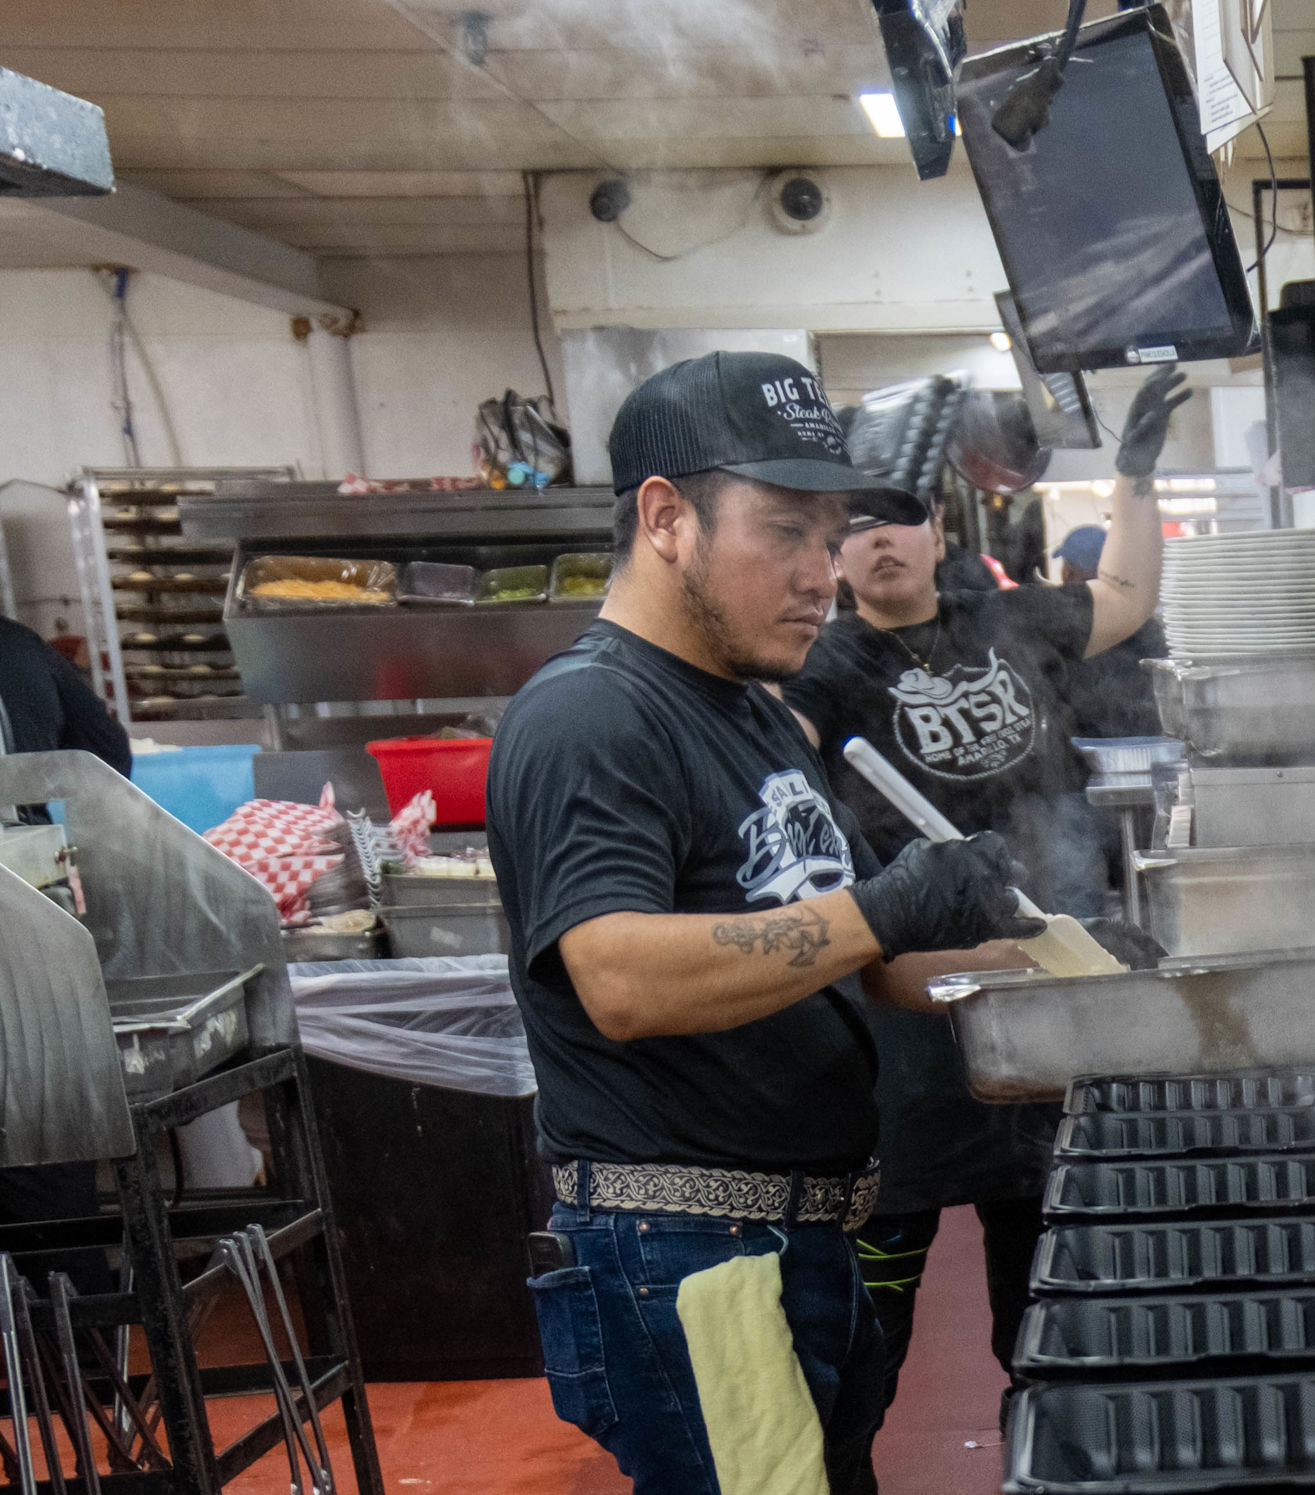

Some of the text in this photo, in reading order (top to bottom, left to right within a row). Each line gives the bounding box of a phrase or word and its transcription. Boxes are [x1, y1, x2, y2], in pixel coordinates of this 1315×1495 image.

[761, 376, 829, 407] BIG TE
[783, 402, 823, 420] Steak
[904, 670, 1031, 754] BTSR
[1008, 732, 1023, 745] TX
[925, 749, 953, 763] HOME
[953, 746, 966, 757] OF
